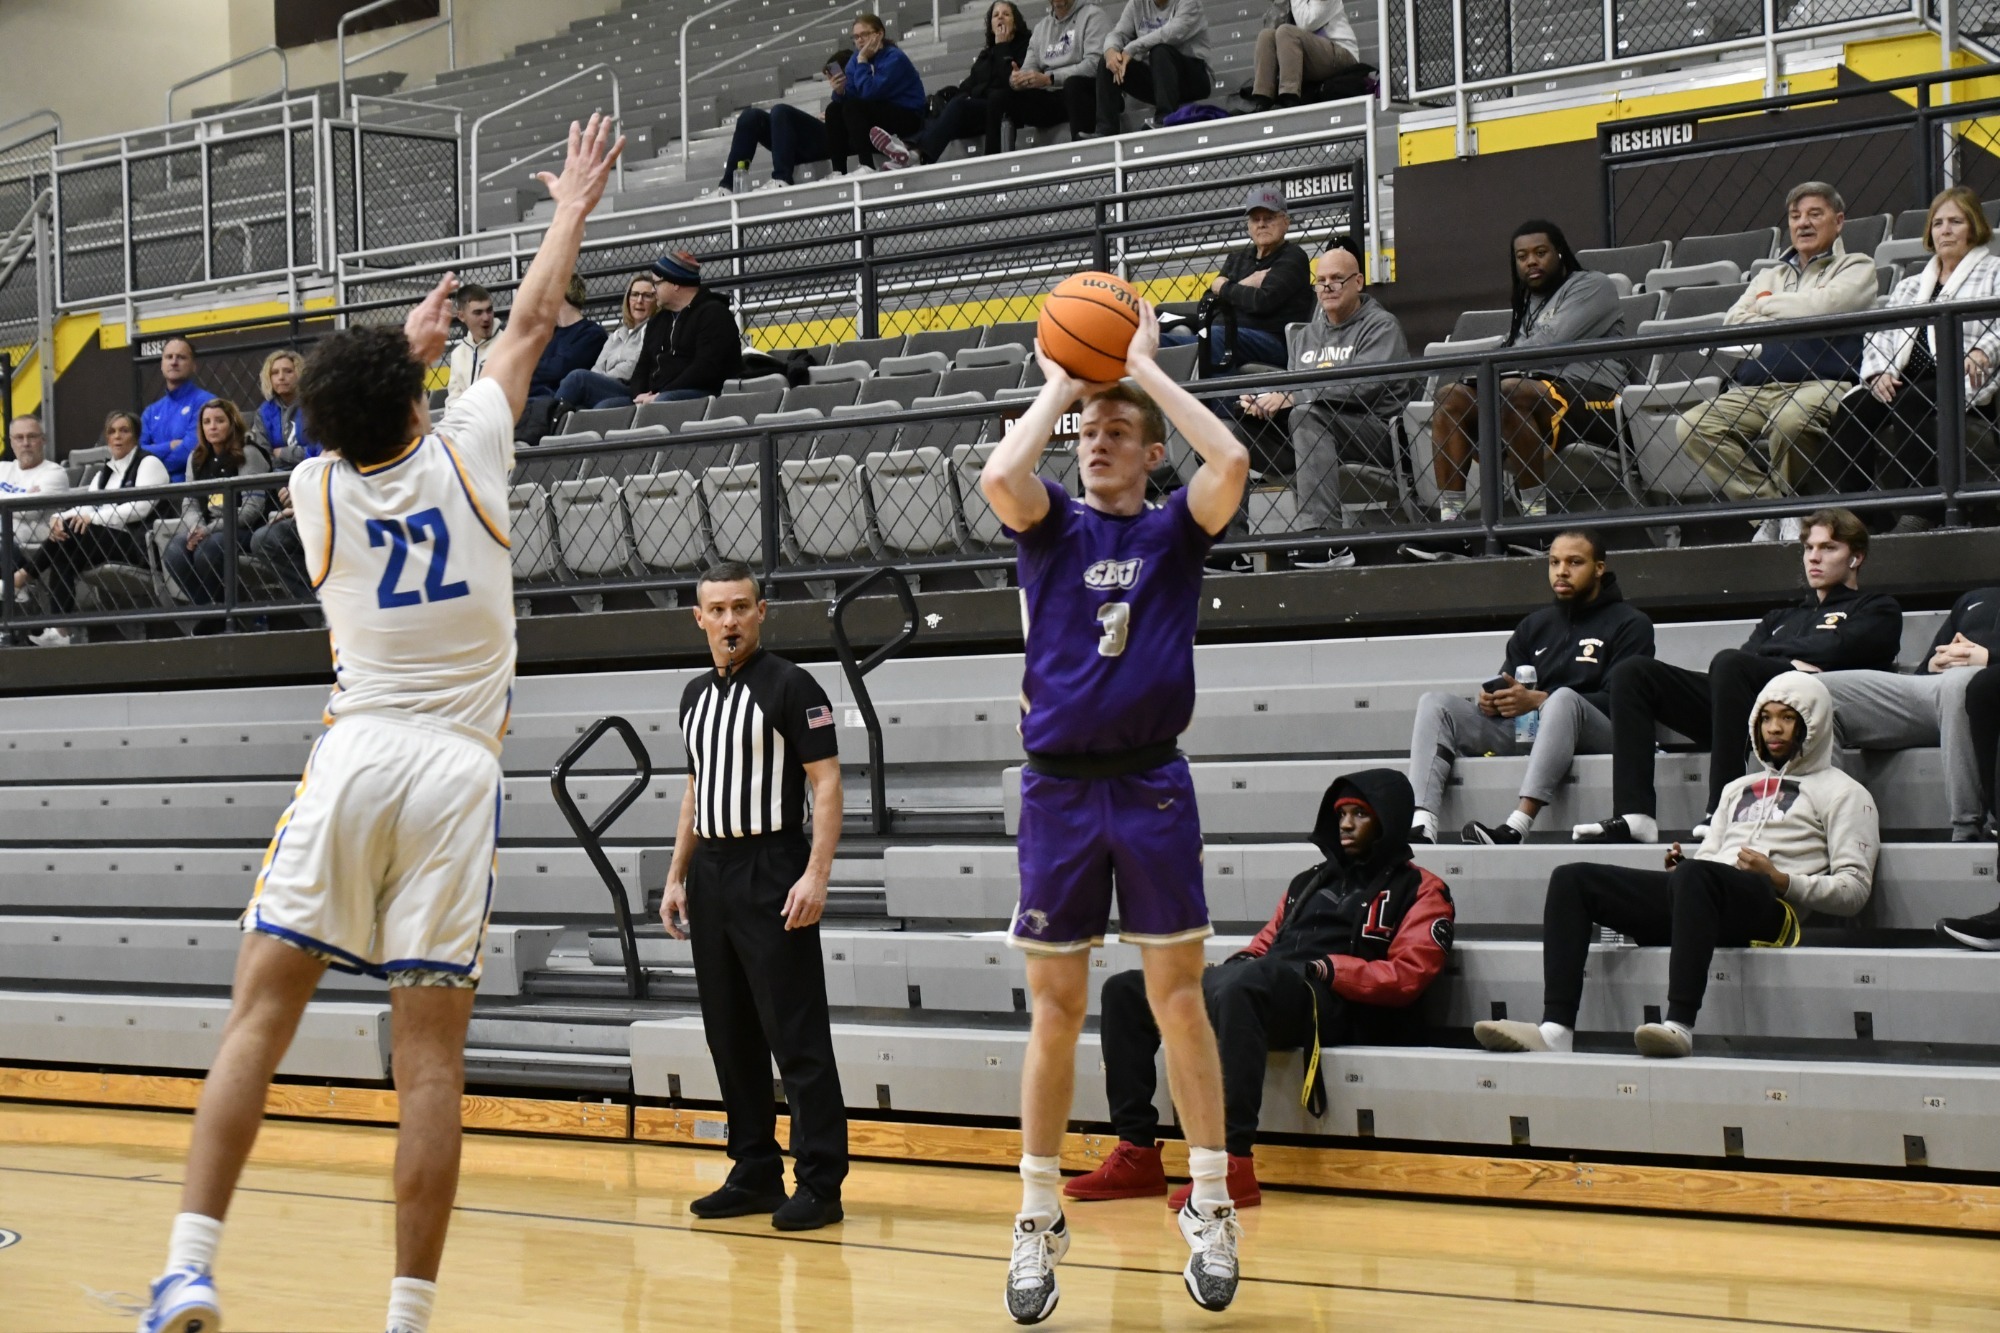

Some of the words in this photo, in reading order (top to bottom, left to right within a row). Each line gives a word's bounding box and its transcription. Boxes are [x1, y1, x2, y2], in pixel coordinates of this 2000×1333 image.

[1611, 123, 1693, 153] RESERVED
[365, 507, 471, 609] 22
[1083, 558, 1143, 590] SBU
[1096, 602, 1130, 657] 3
